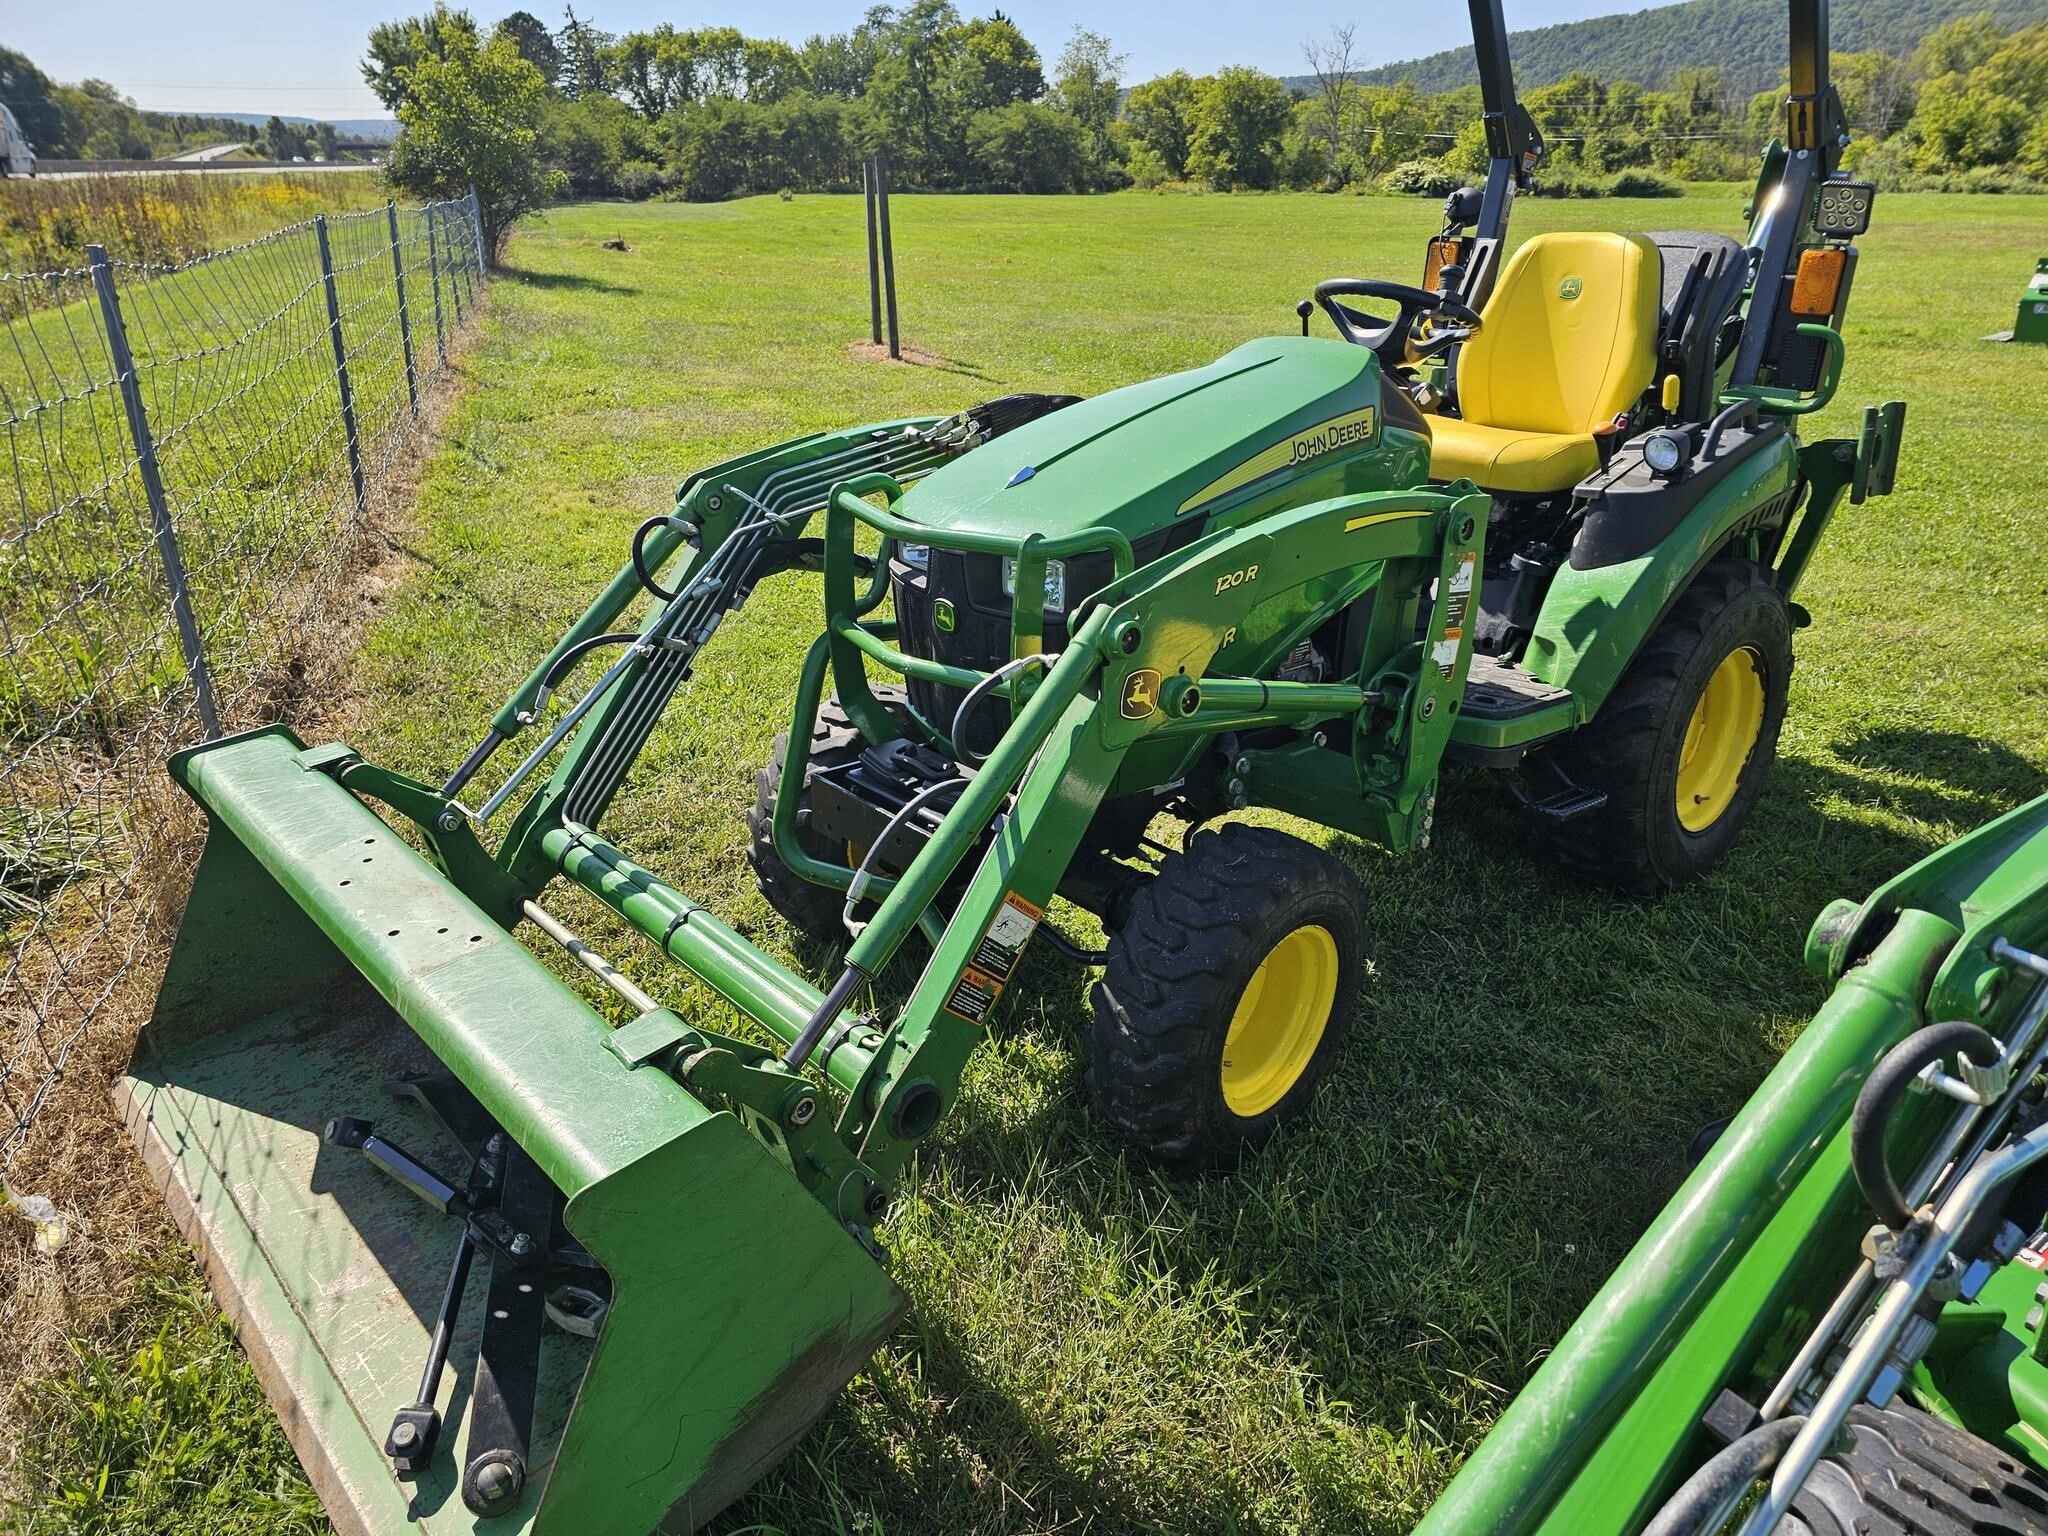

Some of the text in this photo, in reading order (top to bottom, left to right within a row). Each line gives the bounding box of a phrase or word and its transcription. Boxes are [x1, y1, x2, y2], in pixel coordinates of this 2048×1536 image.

[1289, 419, 1371, 465] JOHN DEERE
[1015, 900, 1039, 918] WARNING
